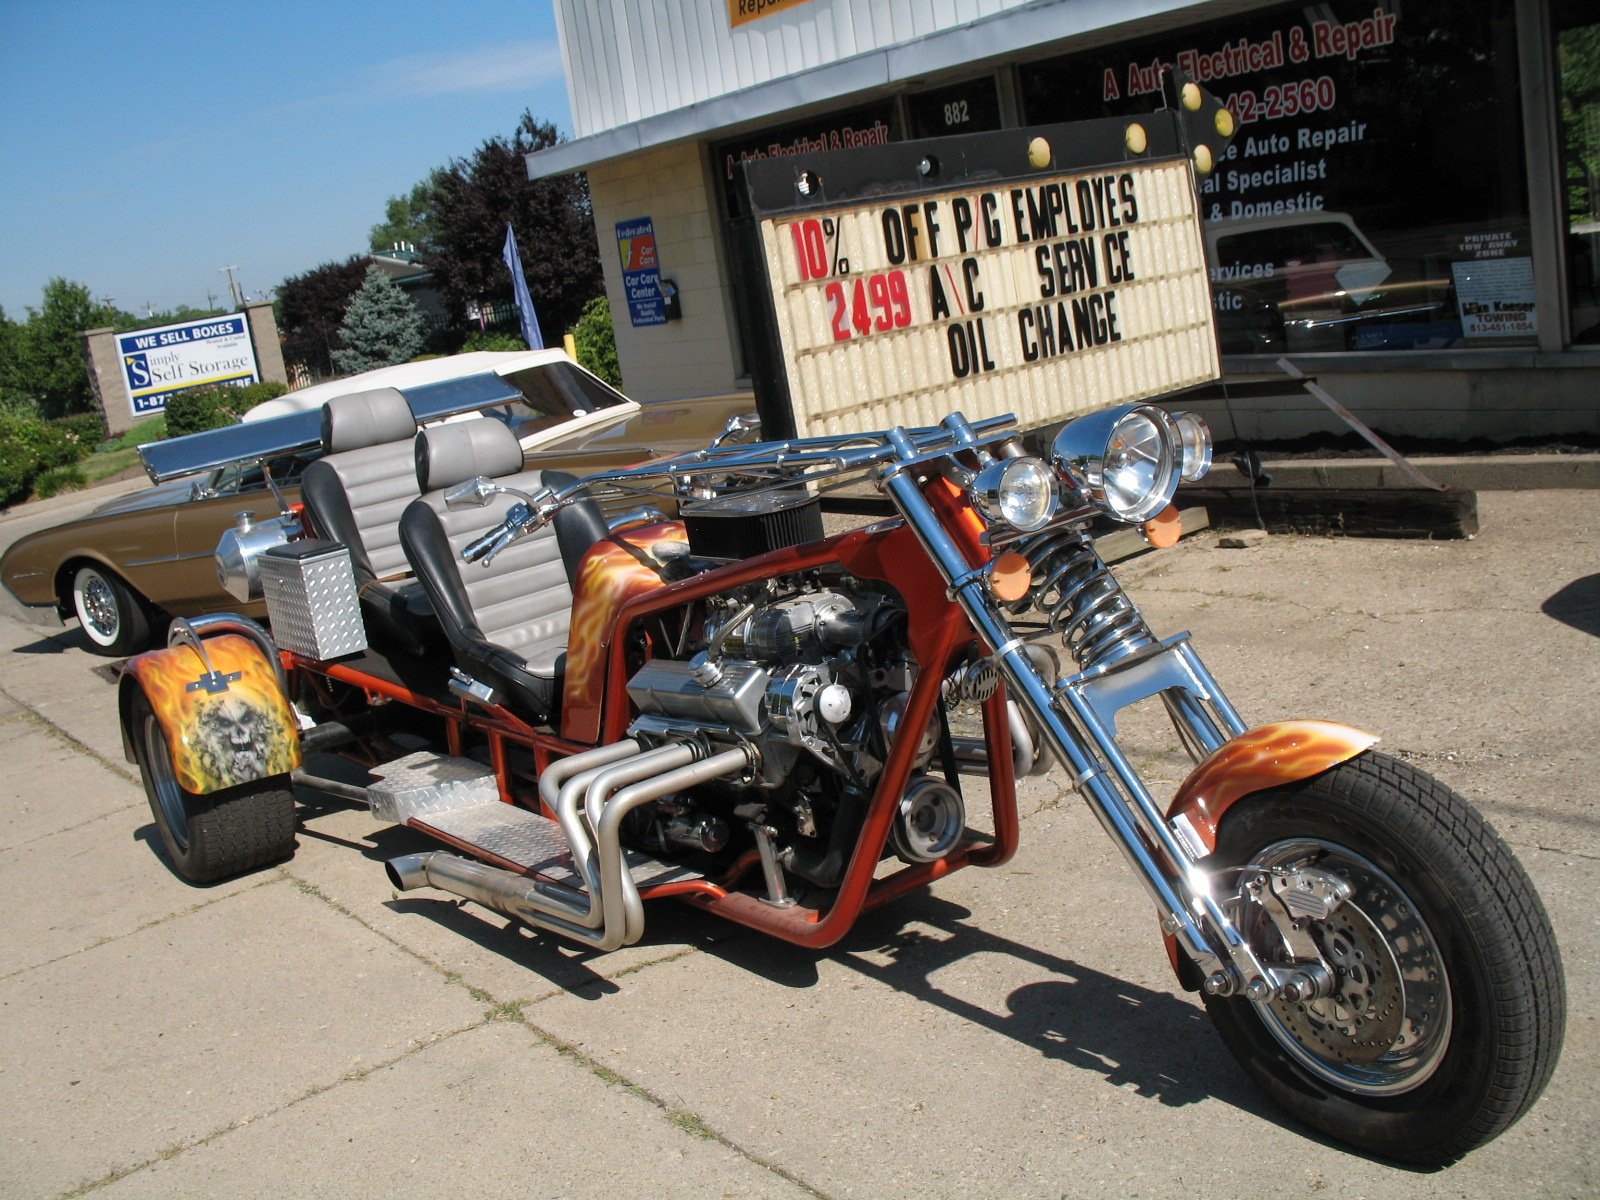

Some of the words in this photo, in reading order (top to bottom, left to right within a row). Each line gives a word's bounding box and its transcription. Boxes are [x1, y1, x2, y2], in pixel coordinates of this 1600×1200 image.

[739, 0, 785, 16] Repa
[1104, 67, 1119, 101] A
[1177, 31, 1283, 83] Electrical
[1289, 26, 1308, 62] &
[1314, 8, 1396, 60] Repair
[944, 100, 969, 126] 882
[1214, 76, 1335, 124] 42-2560
[843, 121, 888, 149] Repair
[1244, 134, 1290, 159] Auto
[1298, 120, 1367, 152] Repair
[1200, 173, 1220, 195] al
[1227, 158, 1327, 194] Specialist
[1210, 202, 1223, 222] &
[1231, 191, 1325, 220] Domestic
[790, 217, 849, 281] 10%
[882, 201, 943, 265] OFF
[1011, 173, 1138, 244] EMPLOYES
[1464, 232, 1512, 242] PRIVATE
[639, 256, 655, 265] Care
[641, 246, 654, 255] Car
[1475, 249, 1505, 258] ZONE
[625, 275, 639, 287] Car
[640, 273, 659, 285] Care
[631, 287, 655, 299] Center
[826, 271, 912, 341] 2499
[1214, 290, 1243, 311] tic
[1475, 312, 1527, 322] TOWING
[136, 335, 157, 349] WE
[160, 330, 189, 345] SELL
[191, 322, 234, 340] BOXES
[947, 318, 994, 378] OIL
[1018, 291, 1121, 362] CHANGE
[152, 363, 183, 383] Self
[189, 356, 249, 376] Storage
